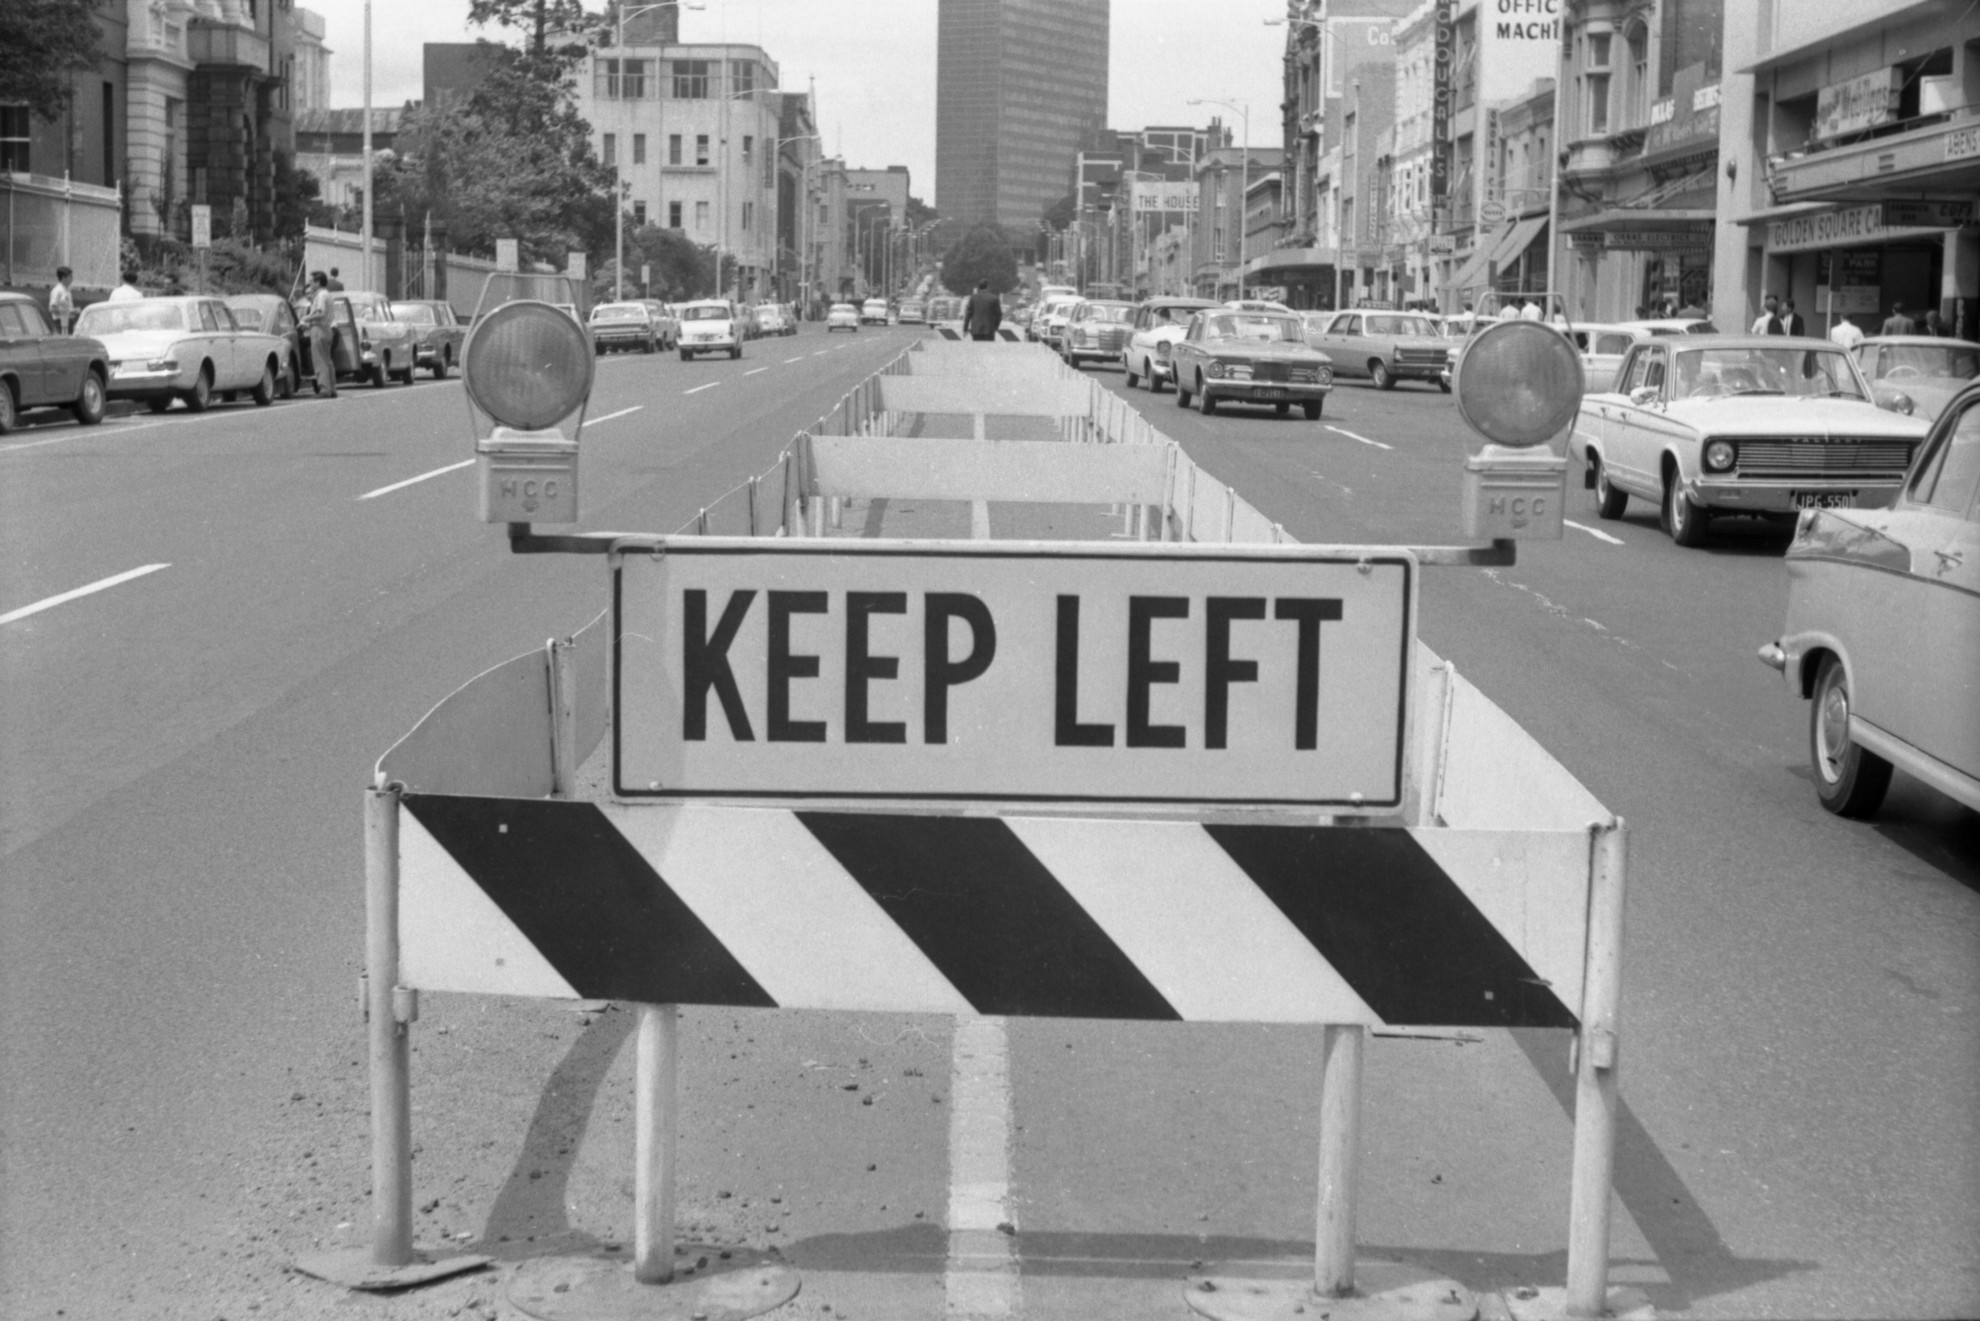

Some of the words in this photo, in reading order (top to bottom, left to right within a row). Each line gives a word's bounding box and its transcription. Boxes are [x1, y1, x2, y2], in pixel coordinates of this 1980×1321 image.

[1138, 195, 1159, 209] THE
[1163, 195, 1199, 209] HOUSE
[1774, 217, 1814, 246] GOLDEN
[1818, 209, 1861, 241] SQUARE
[1865, 208, 1888, 233] CA
[683, 589, 996, 745] KEEP
[1055, 594, 1343, 751] LEFT
